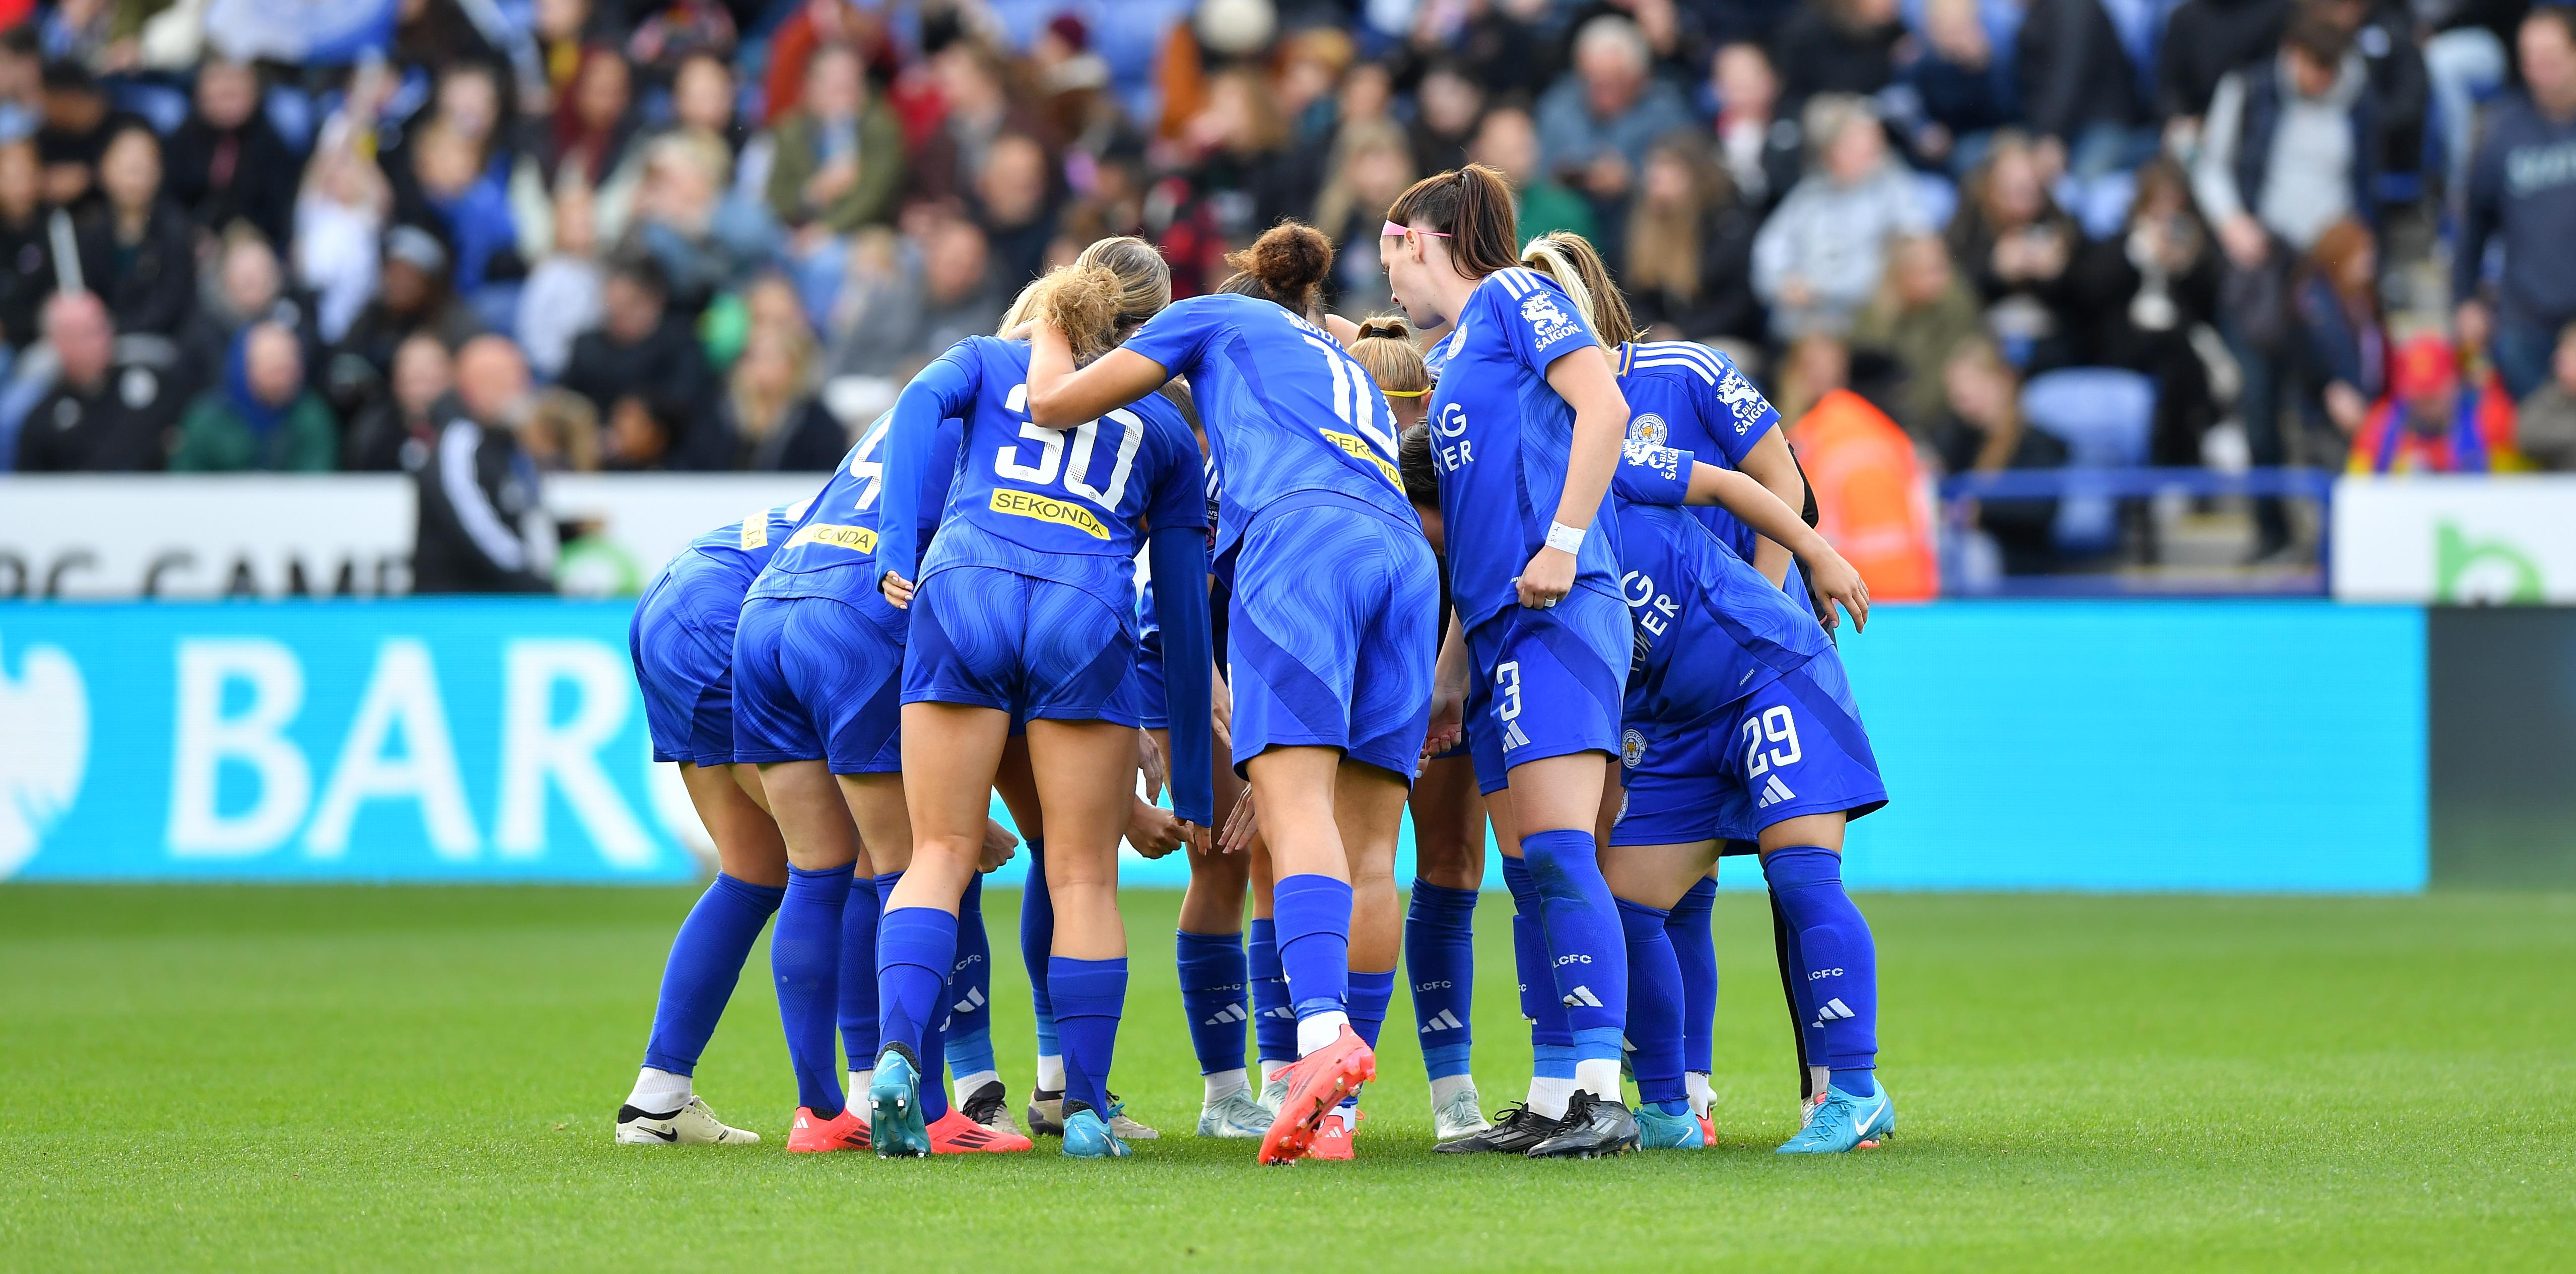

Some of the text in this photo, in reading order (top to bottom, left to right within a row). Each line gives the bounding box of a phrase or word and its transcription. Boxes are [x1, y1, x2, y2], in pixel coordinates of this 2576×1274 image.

[1544, 323, 1561, 334] BIA
[1734, 397, 1770, 436] SAIGO
[1741, 401, 1756, 415] BIA
[994, 383, 1143, 513] 30
[1661, 447, 1679, 480] SAIGO
[995, 493, 1104, 537] SEKONDA
[813, 528, 869, 548] ONDA
[1631, 594, 1680, 672] OWER
[1497, 661, 1521, 722] 3
[168, 635, 718, 871] BAR
[1742, 705, 1801, 780] 29
[952, 954, 982, 974] CFC
[1552, 954, 1592, 968] LCFC
[1807, 967, 1844, 981] LCFC
[1416, 980, 1452, 993] LCFC
